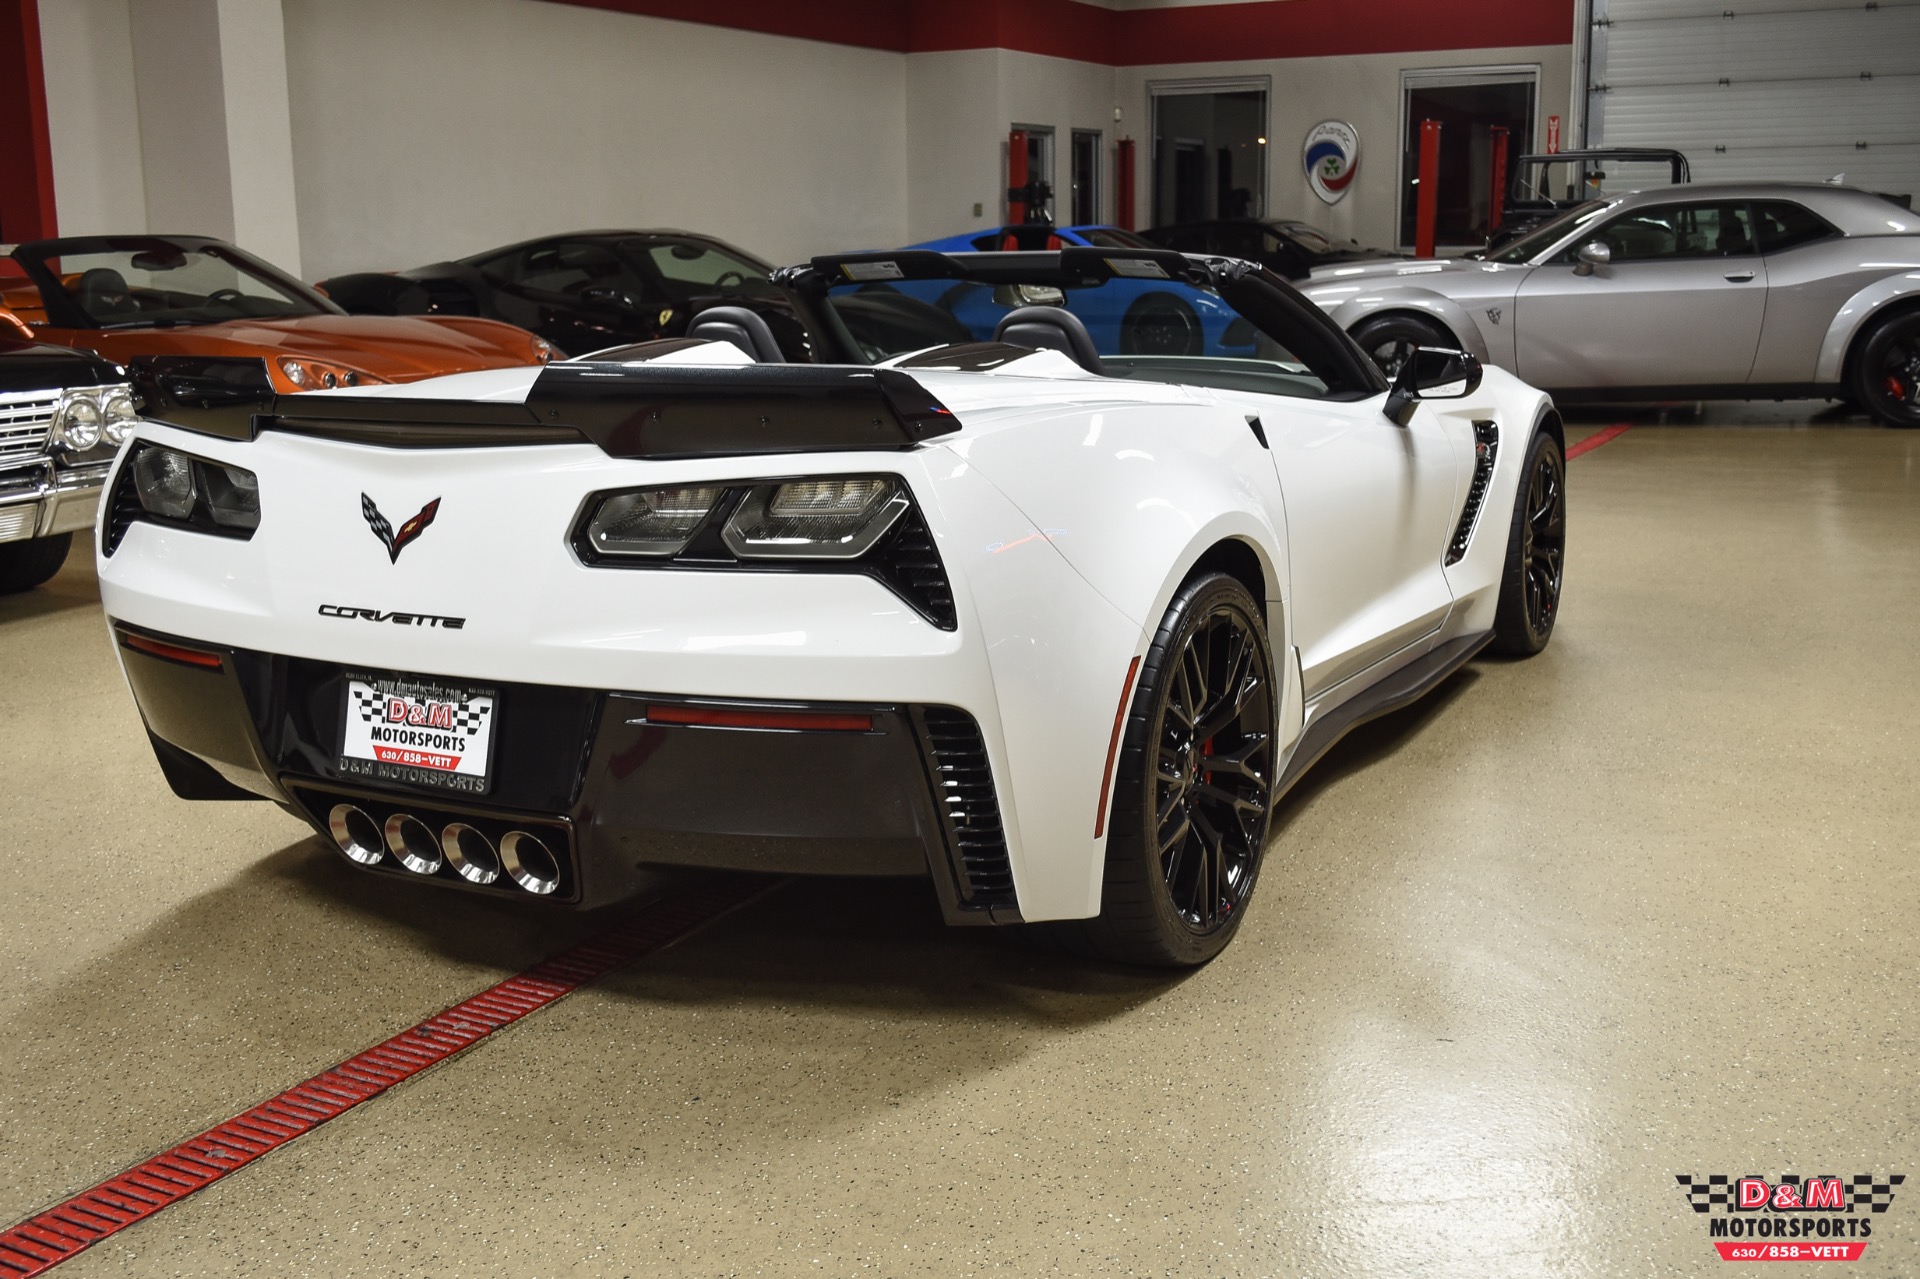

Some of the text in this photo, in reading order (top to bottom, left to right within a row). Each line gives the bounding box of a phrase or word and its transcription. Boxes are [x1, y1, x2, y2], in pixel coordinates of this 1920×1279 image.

[318, 604, 466, 629] CORVETTE
[377, 676, 462, 704] www.dmautosales.com
[388, 697, 453, 729] D&M
[371, 726, 466, 752] MOTORSPORTS
[381, 750, 452, 768] 630/858-VETT
[340, 758, 485, 792] D&M MOTORSPORTS
